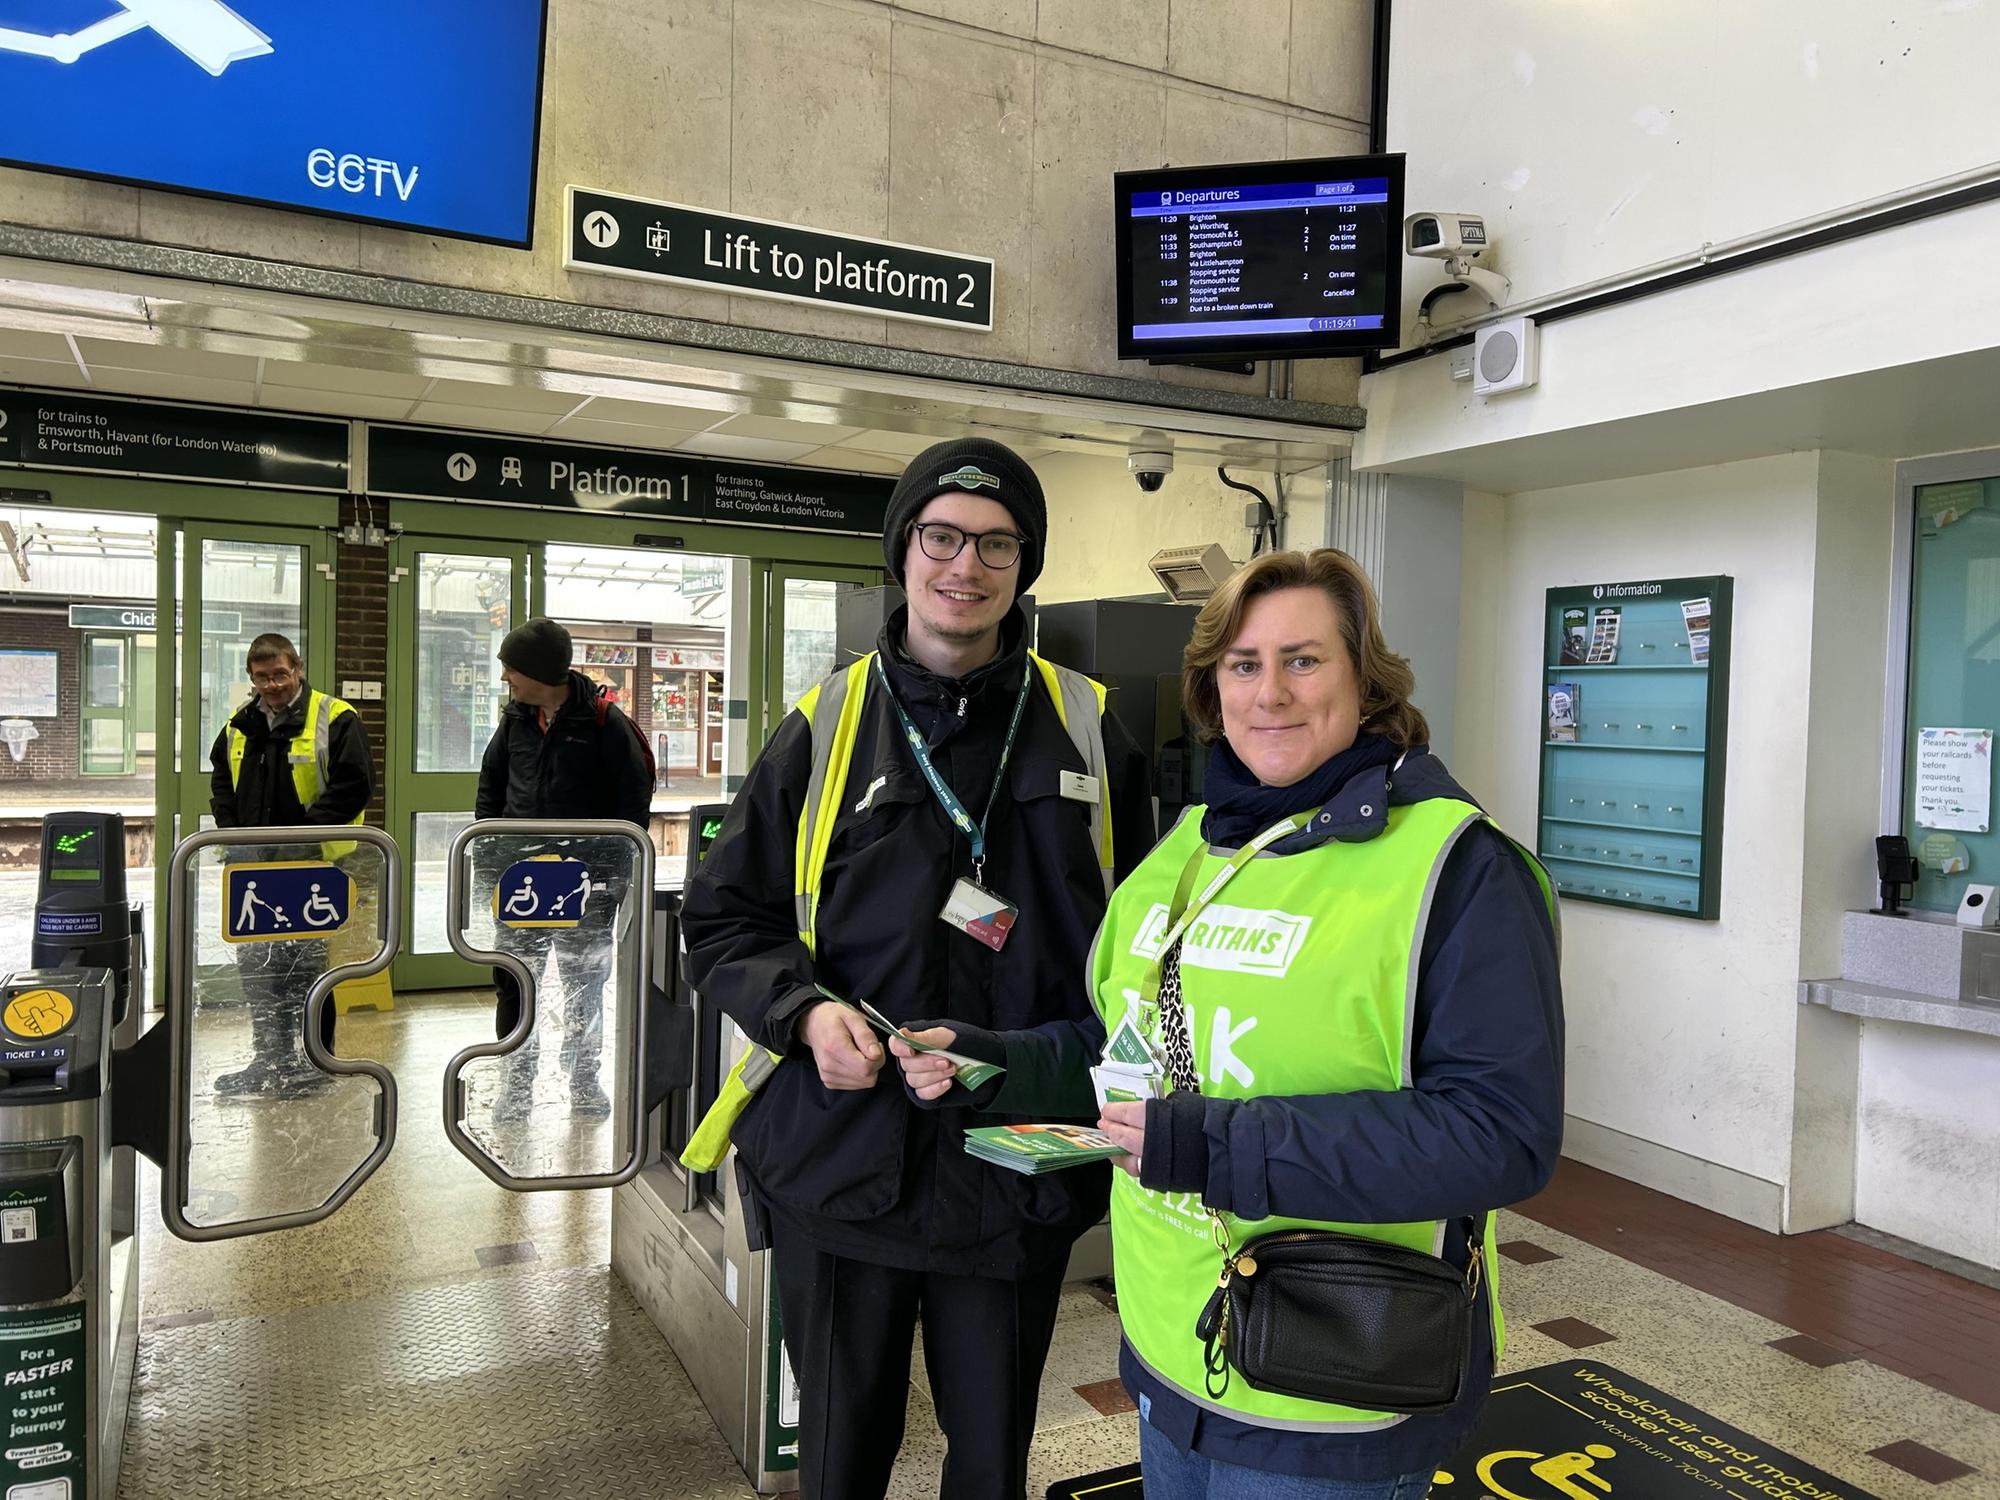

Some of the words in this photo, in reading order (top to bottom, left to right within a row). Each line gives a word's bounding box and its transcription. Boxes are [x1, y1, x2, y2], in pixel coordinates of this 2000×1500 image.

[306, 148, 419, 201] CCTV
[1319, 186, 1335, 194] Page
[1350, 184, 1355, 192] 2
[1176, 190, 1240, 204] Departures
[1189, 214, 1216, 222] Brighton
[1339, 205, 1356, 213] 11:21
[1189, 231, 1226, 240] Portsmouth
[1234, 230, 1239, 238] S
[1304, 226, 1309, 234] 2
[1200, 222, 1229, 230] Worthing
[1189, 241, 1232, 249] Southampton
[1341, 233, 1356, 241] time
[1189, 250, 1216, 259] Brighton
[704, 228, 760, 274] Lift
[770, 244, 804, 280] to
[815, 251, 948, 304] platform
[956, 273, 976, 308] 2
[1200, 258, 1244, 267] Littlehampton
[1189, 269, 1217, 277] Stopping
[1189, 277, 1226, 285] Portsmouth
[1303, 272, 1308, 280] 2
[1340, 270, 1355, 278] time
[1189, 287, 1217, 295] Stopping
[1323, 288, 1355, 297] Cancelled
[1217, 303, 1238, 311] broken
[1240, 302, 1257, 310] down
[1318, 319, 1357, 329] 11:19:41
[38, 407, 55, 421] for
[58, 411, 92, 425] trains
[95, 414, 108, 426] to
[38, 423, 104, 440] Emsworth,
[106, 429, 149, 444] Havant
[152, 433, 172, 446] (for
[175, 435, 219, 450] London
[221, 440, 277, 457] Waterloo)
[38, 437, 48, 450] &
[51, 438, 123, 456] Portsmouth
[550, 461, 671, 501] Platform
[681, 474, 690, 502] 1
[715, 473, 727, 484] for
[730, 475, 753, 487] trains
[755, 478, 764, 488] to
[715, 485, 758, 501] Worthing,
[759, 490, 793, 502] Gatwick
[794, 493, 826, 507] Airport,
[715, 498, 733, 509] East
[735, 500, 771, 513] Croydon
[772, 503, 780, 513] &
[781, 504, 812, 516] London
[814, 507, 845, 519] Victoria
[1606, 582, 1662, 597] Information
[1923, 739, 1946, 747] Please
[1941, 751, 1972, 759] railcards
[1922, 773, 1961, 783] requesting
[1921, 796, 1943, 804] Thank
[5, 1050, 36, 1060] TICKET
[20, 1196, 47, 1206] reader
[20, 1349, 44, 1361] For
[46, 1348, 55, 1358] a
[4, 1358, 74, 1387] FASTER
[20, 1386, 56, 1400] start
[11, 1407, 27, 1418] to
[30, 1402, 64, 1419] your
[1574, 1368, 1701, 1434] Wheelchair
[1701, 1434, 1759, 1463] and
[9, 1418, 66, 1438] journey
[1580, 1390, 1669, 1435] scooter
[1668, 1436, 1725, 1465] user
[10, 1448, 37, 1458] Travel
[38, 1443, 59, 1454] with
[1594, 1419, 1673, 1463] Maximum
[1675, 1463, 1724, 1490] 70cm
